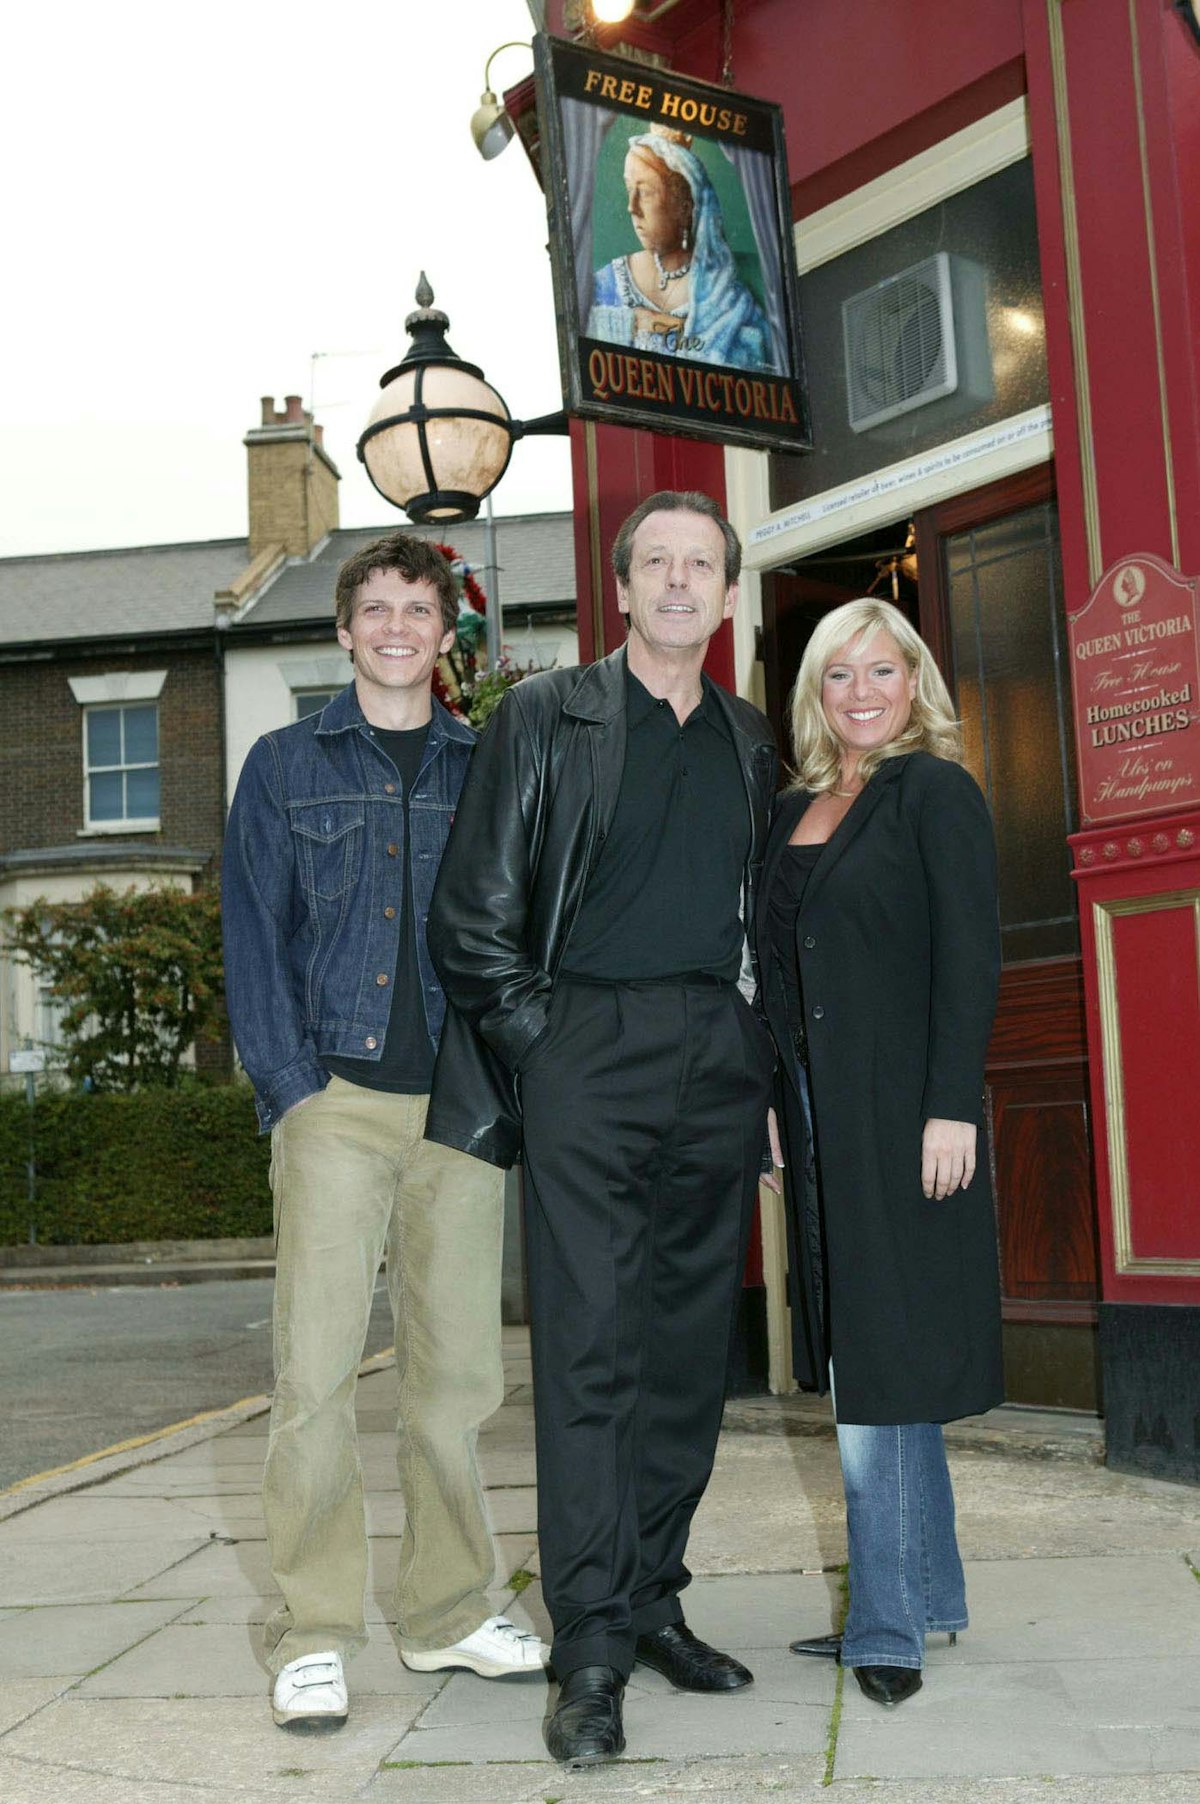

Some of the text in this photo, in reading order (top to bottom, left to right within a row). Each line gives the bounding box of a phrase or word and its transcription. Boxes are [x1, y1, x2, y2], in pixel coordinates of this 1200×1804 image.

[584, 70, 748, 136] FREE HOUSE
[587, 349, 799, 425] QUEEN VICTORIA
[755, 524, 775, 539] PEGGY
[783, 511, 811, 527] MITCHELL
[822, 494, 848, 513] Licensed
[849, 487, 870, 501] retailer
[898, 472, 916, 483] wines
[923, 459, 944, 474] spirits
[952, 452, 961, 462] be
[962, 436, 996, 459] consumed
[1016, 424, 1027, 438] off
[1027, 421, 1039, 432] the
[1076, 615, 1192, 660] QUEEN VICTORIA
[1121, 610, 1141, 625] THE
[1090, 661, 1182, 693] Free House
[1087, 684, 1192, 725] Homecooked
[1091, 709, 1191, 749] LUNCHES
[1154, 760, 1173, 772] on
[1093, 773, 1195, 802] Handpumps
